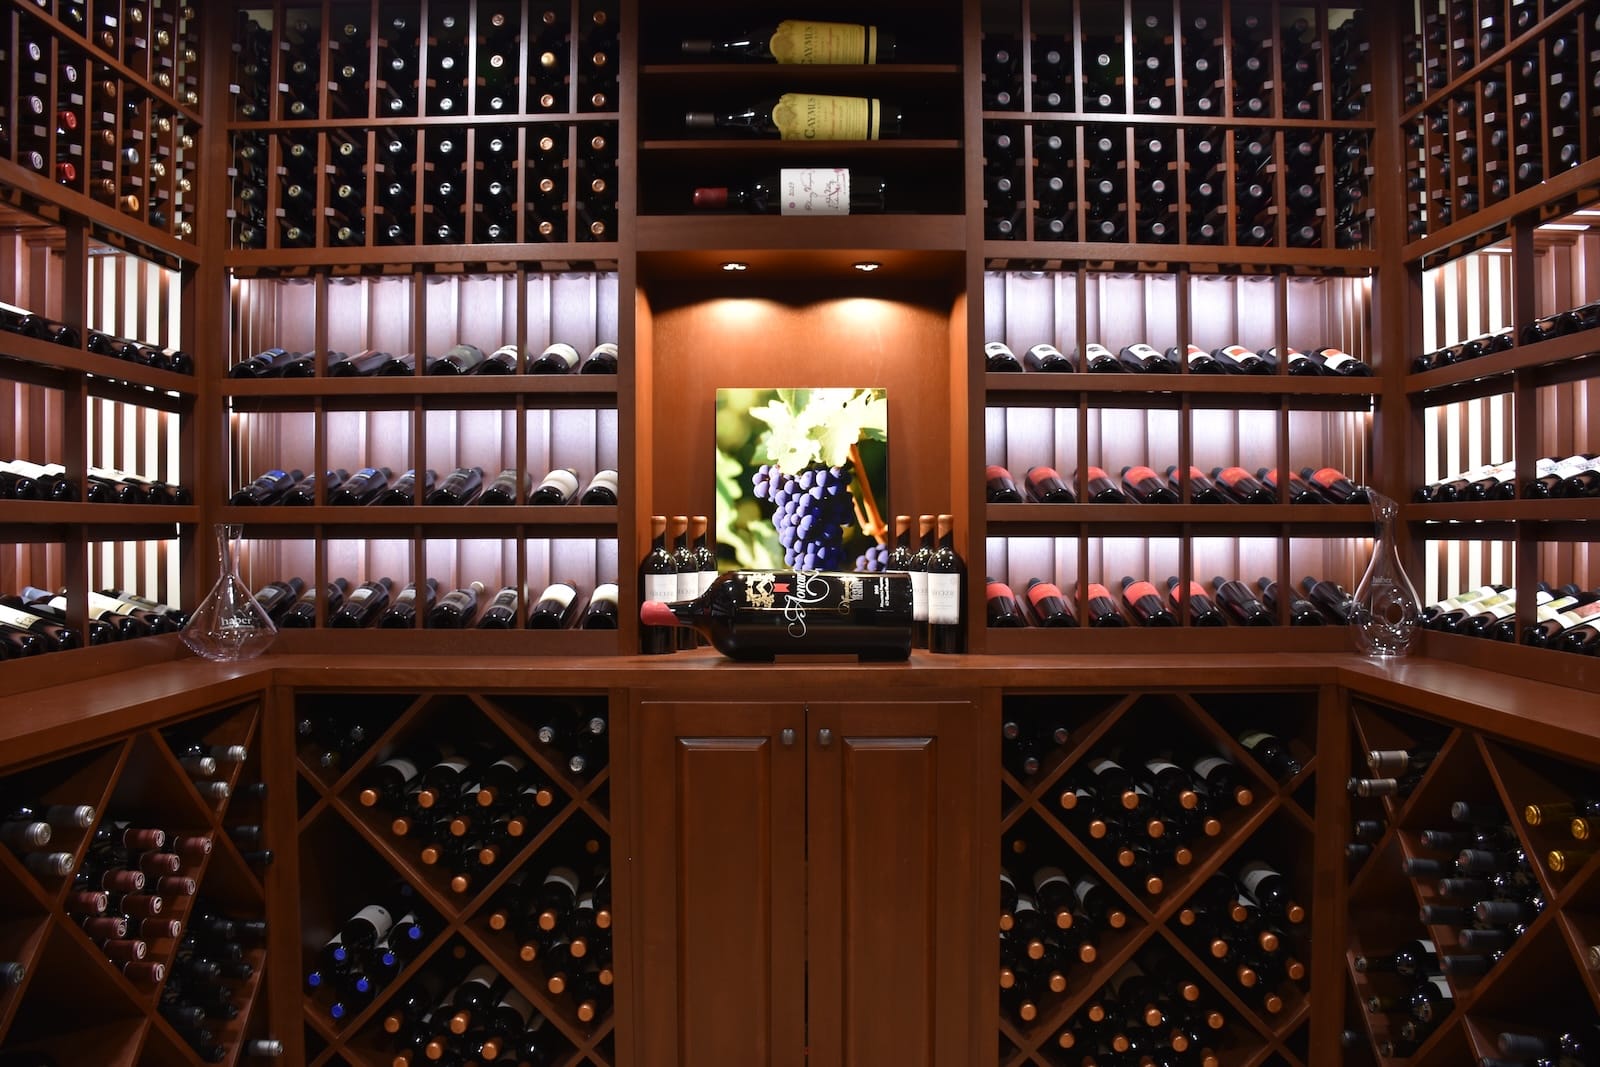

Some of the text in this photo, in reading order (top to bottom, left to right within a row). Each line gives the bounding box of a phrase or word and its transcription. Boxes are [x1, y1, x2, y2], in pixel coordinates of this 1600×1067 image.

[801, 26, 814, 65] CAYMUS
[804, 96, 816, 139] CAYMUS
[221, 616, 252, 626] haber
